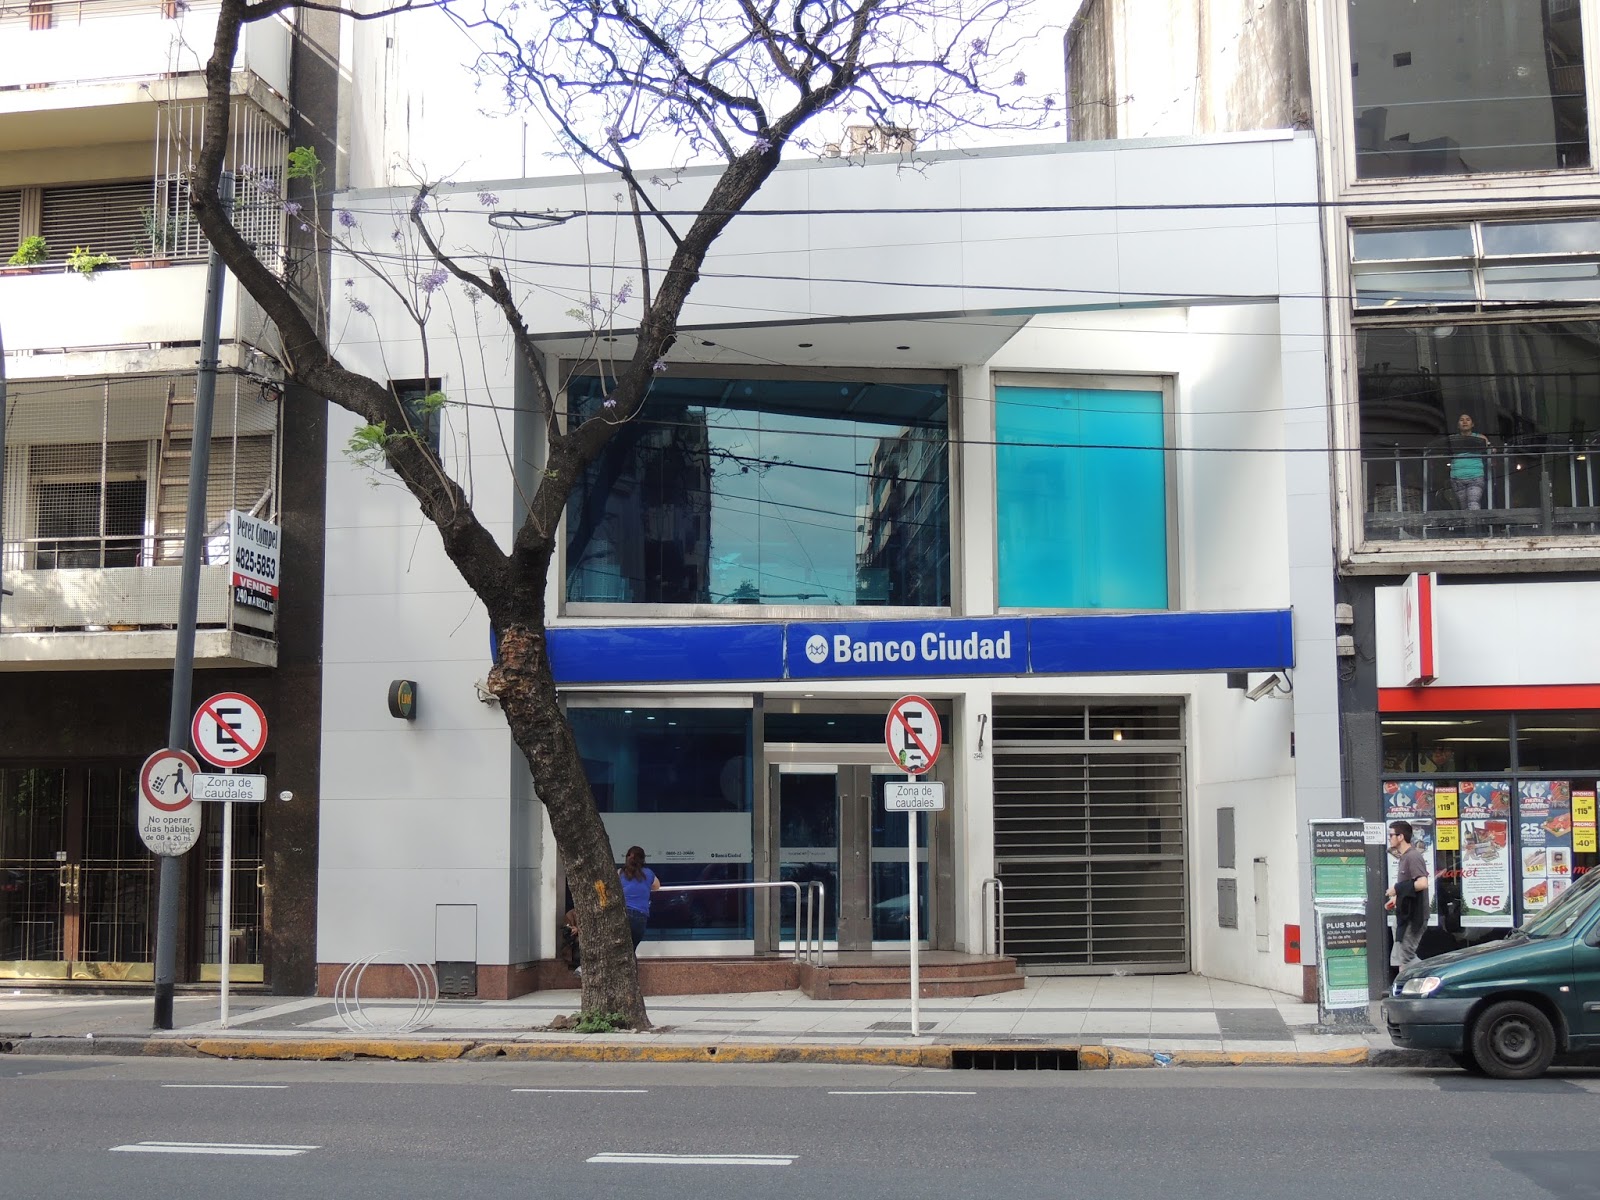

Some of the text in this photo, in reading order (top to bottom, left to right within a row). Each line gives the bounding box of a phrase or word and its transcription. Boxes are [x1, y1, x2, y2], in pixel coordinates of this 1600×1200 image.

[235, 546, 276, 580] 4825-5853
[239, 576, 272, 596] VENDE
[236, 588, 248, 604] 240
[834, 631, 1011, 663] Banco Ciudad
[216, 708, 241, 744] E
[904, 712, 922, 749] E
[207, 777, 252, 788] Zona de
[204, 788, 253, 799] caudales
[897, 785, 933, 796] Zona de
[895, 797, 935, 808] caudales
[148, 816, 191, 825] No operar
[164, 825, 195, 833] hábiles
[1520, 822, 1545, 836] 25%
[1471, 895, 1501, 906] $165
